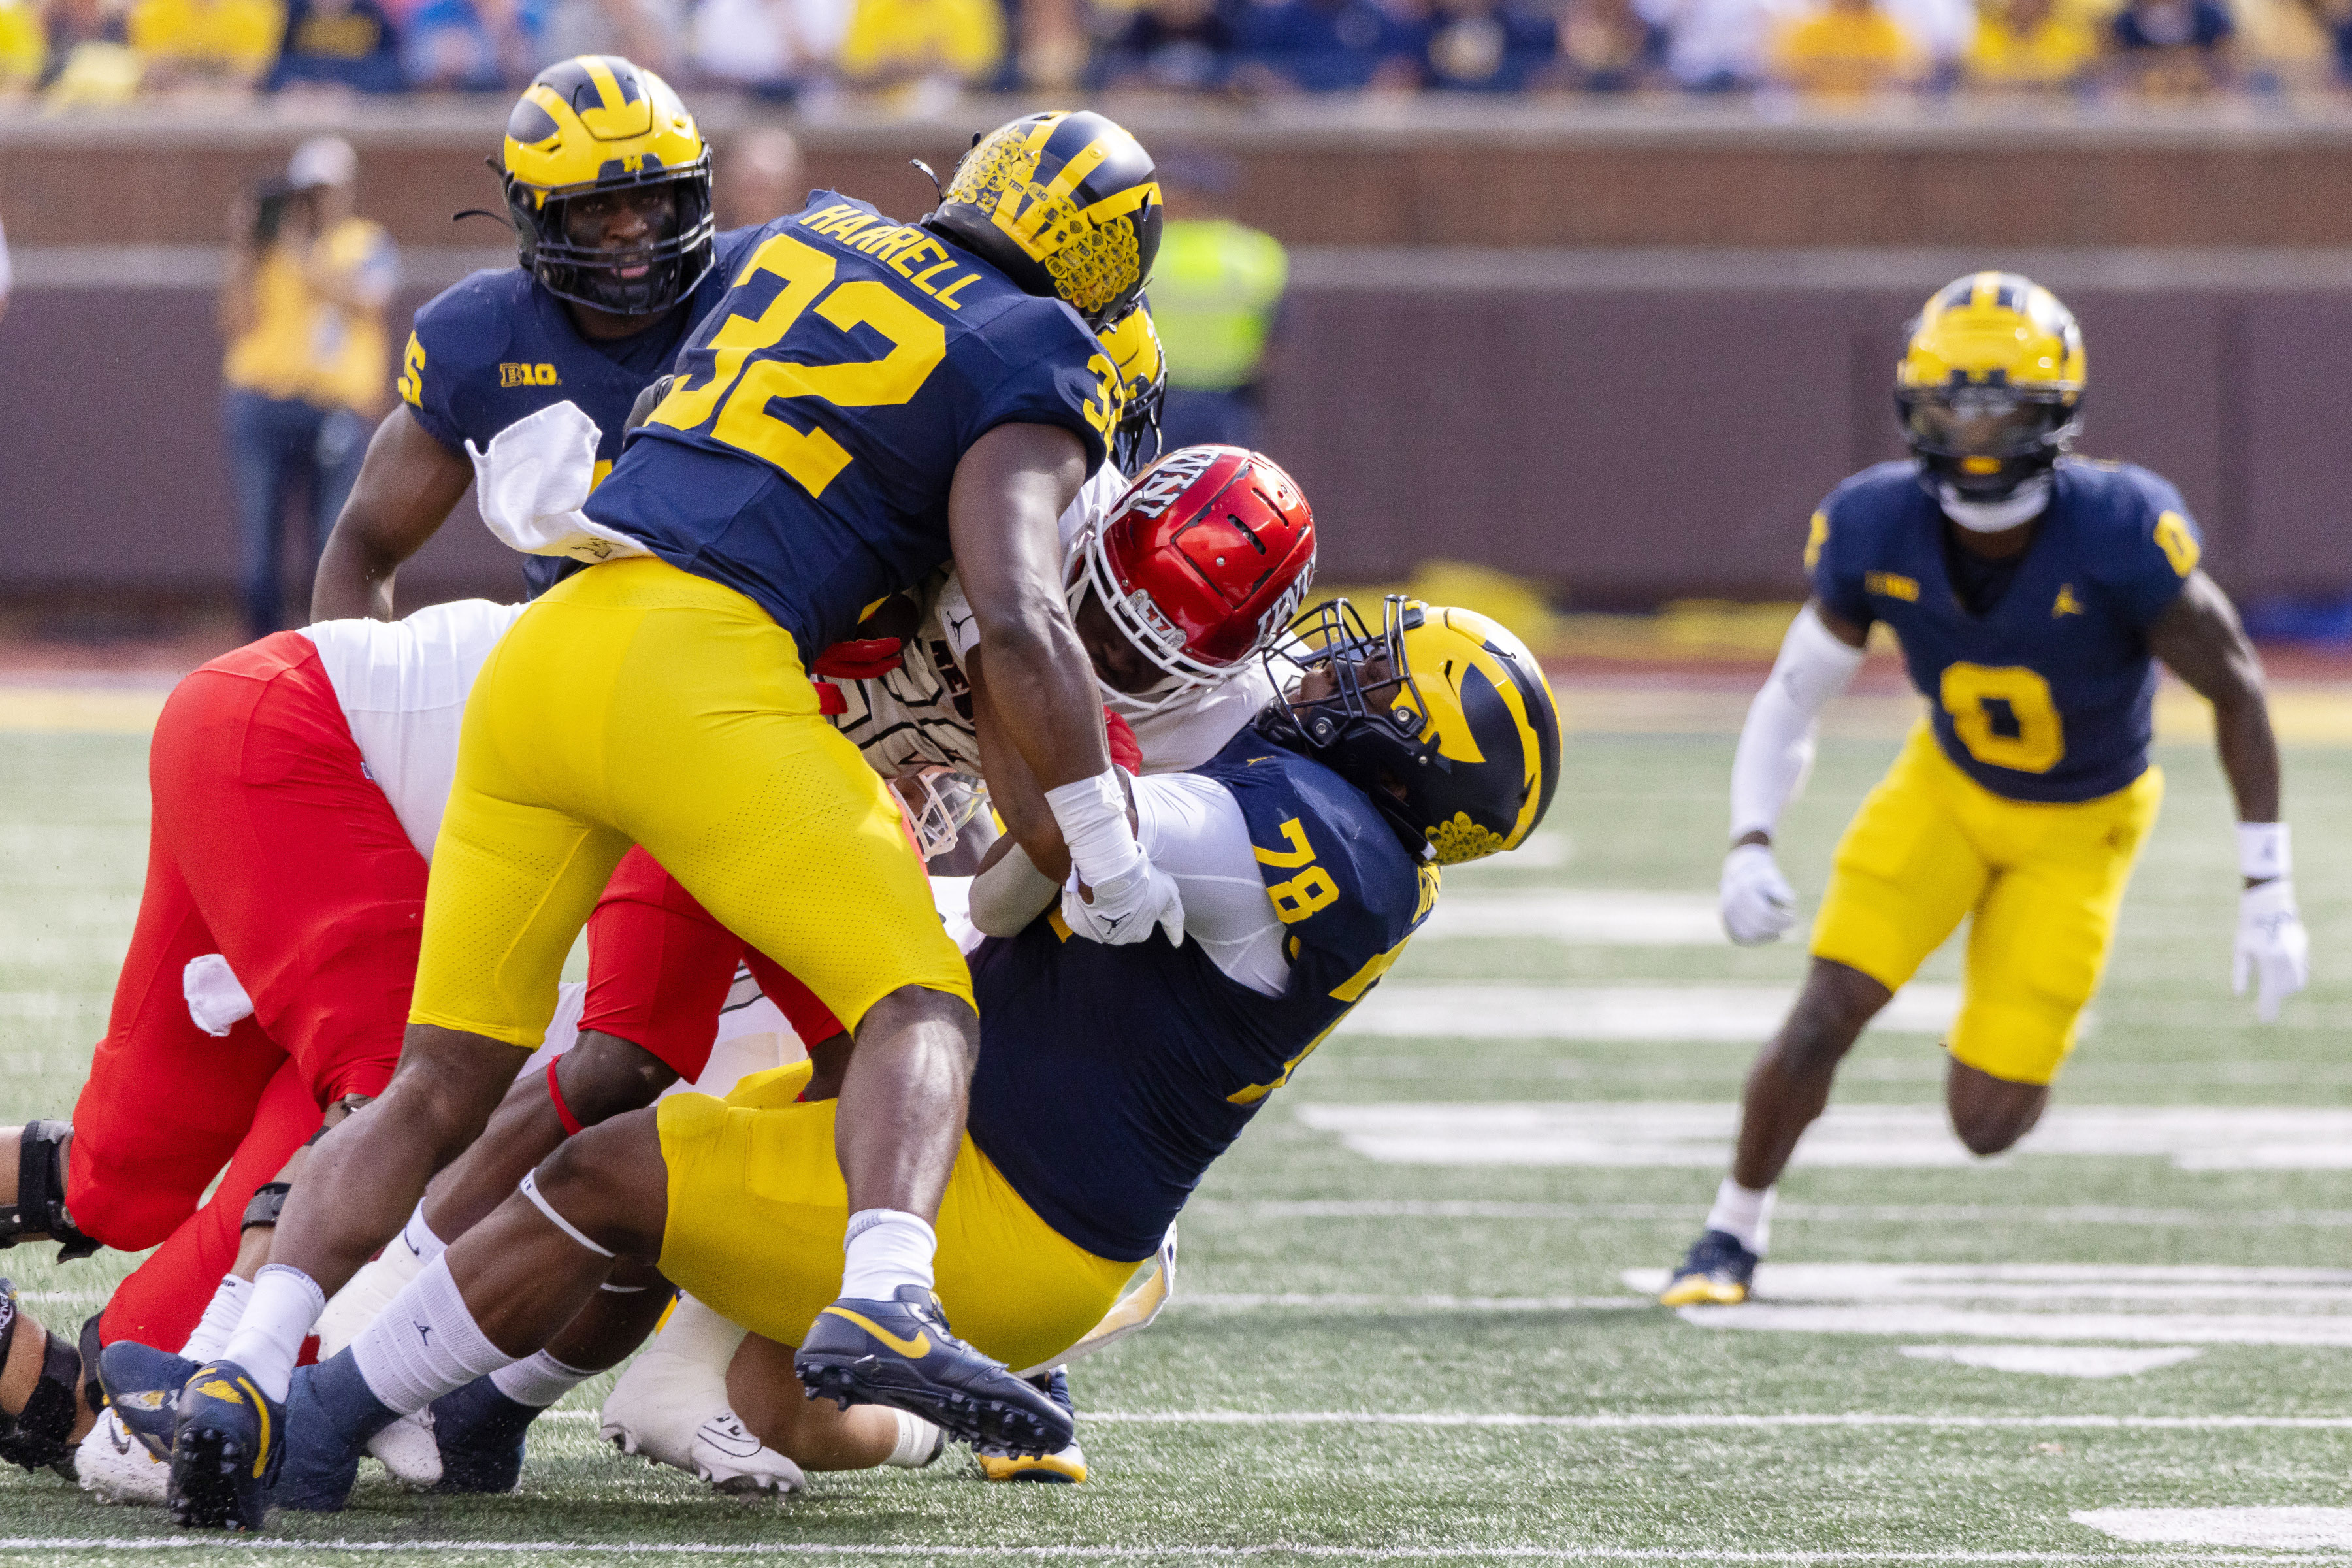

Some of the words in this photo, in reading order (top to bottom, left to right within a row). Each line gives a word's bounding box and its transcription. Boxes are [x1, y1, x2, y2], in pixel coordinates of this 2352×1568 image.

[976, 191, 998, 214] 32
[799, 204, 983, 312] HARRELL
[642, 233, 947, 500] 32
[2153, 510, 2202, 578] 0
[1145, 603, 1173, 632] 47
[1938, 659, 2067, 774] 0
[1252, 817, 1340, 924] 78
